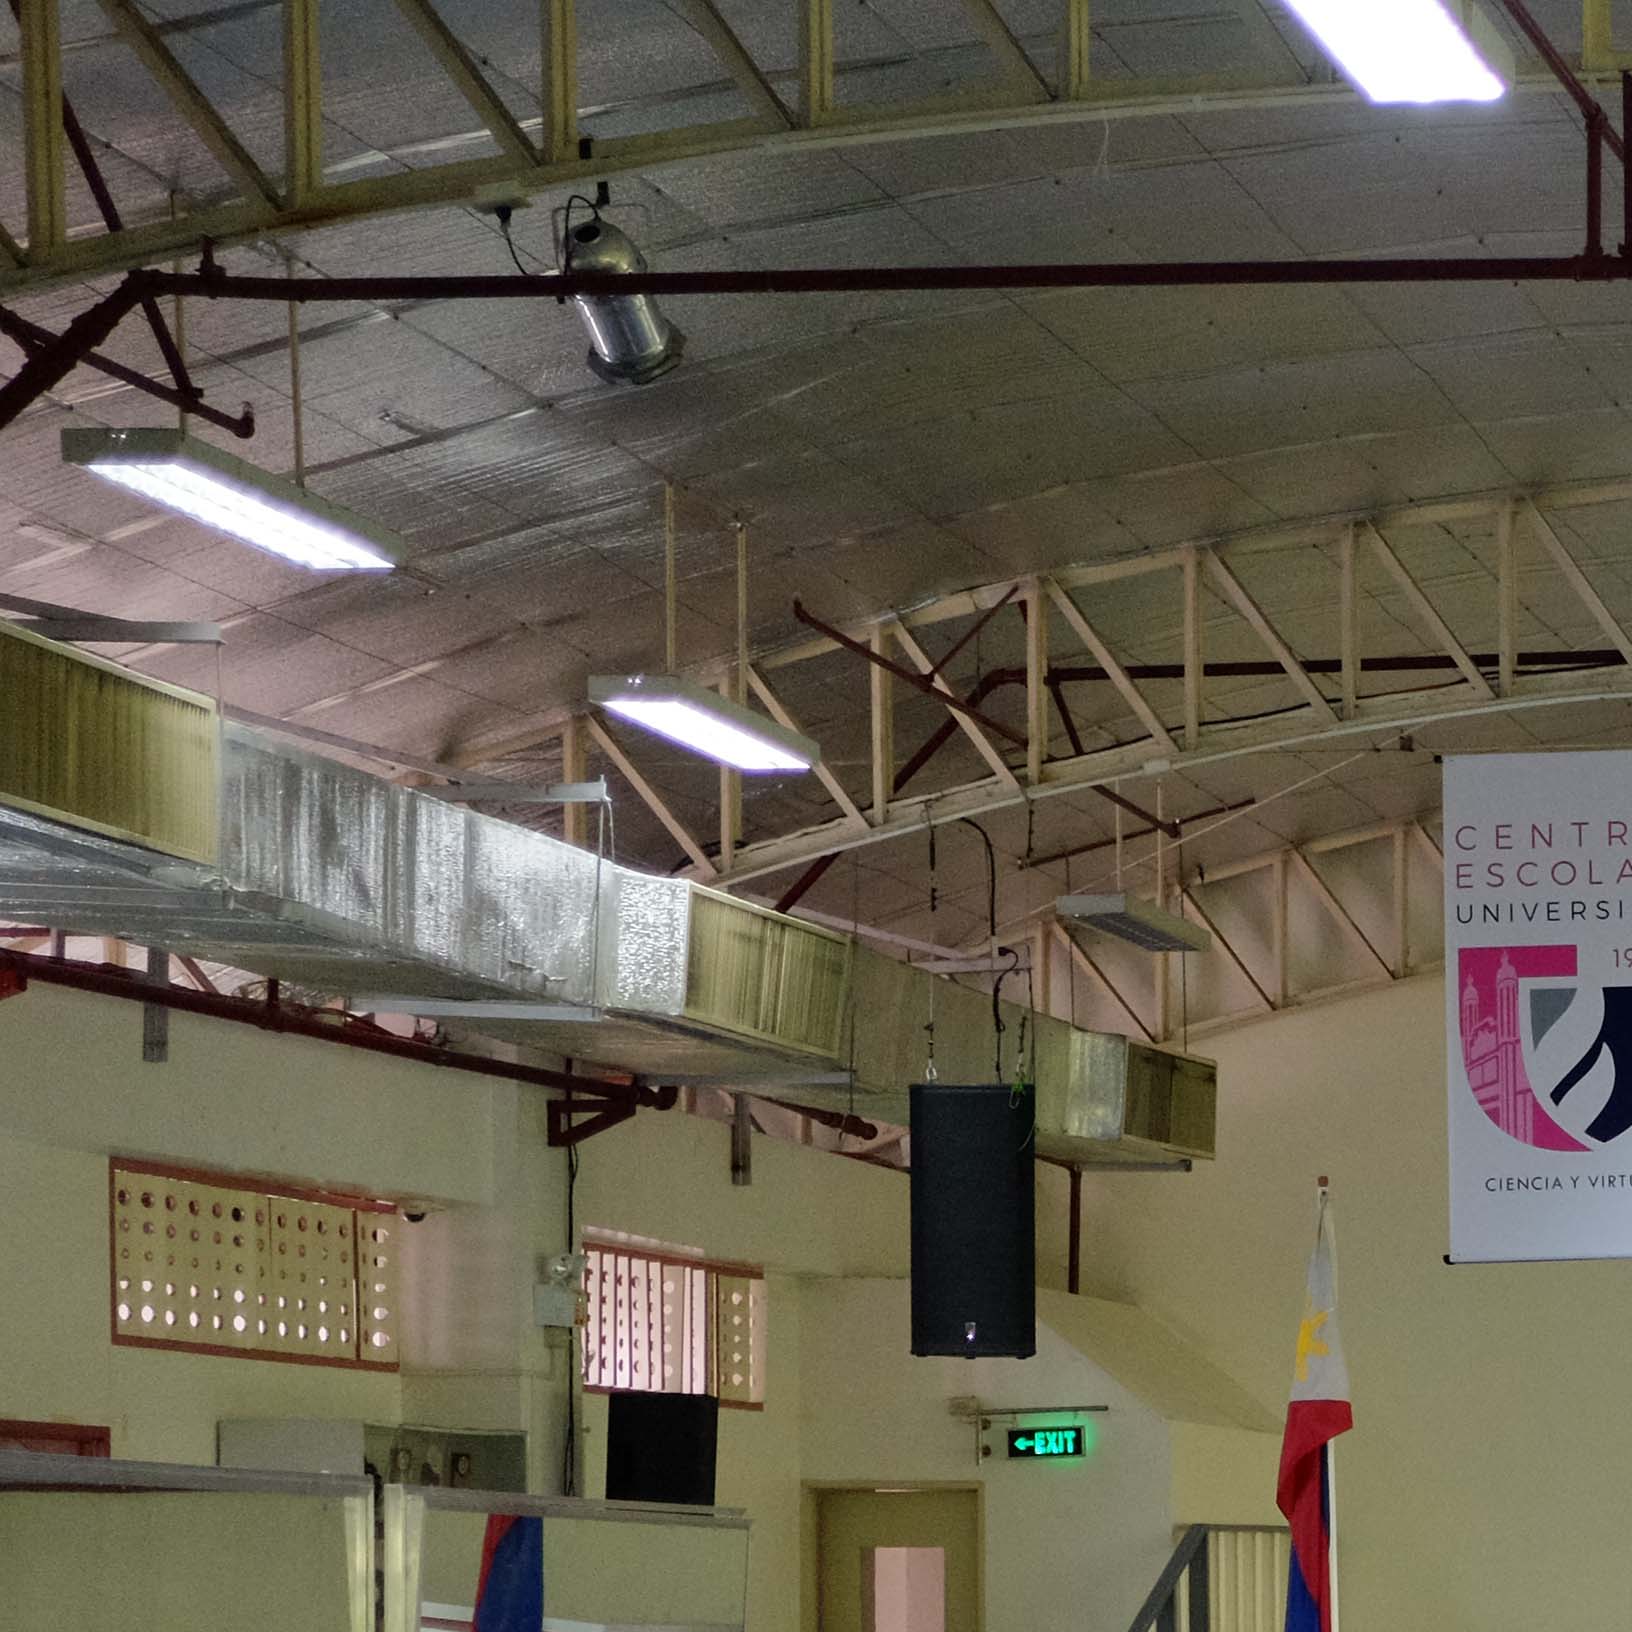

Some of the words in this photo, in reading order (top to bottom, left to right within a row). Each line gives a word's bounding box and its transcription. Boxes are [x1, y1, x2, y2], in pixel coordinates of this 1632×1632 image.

[1484, 1174, 1564, 1193] CIENCIA
[1568, 1175, 1582, 1190] Y
[1034, 1430, 1077, 1455] EXIT
